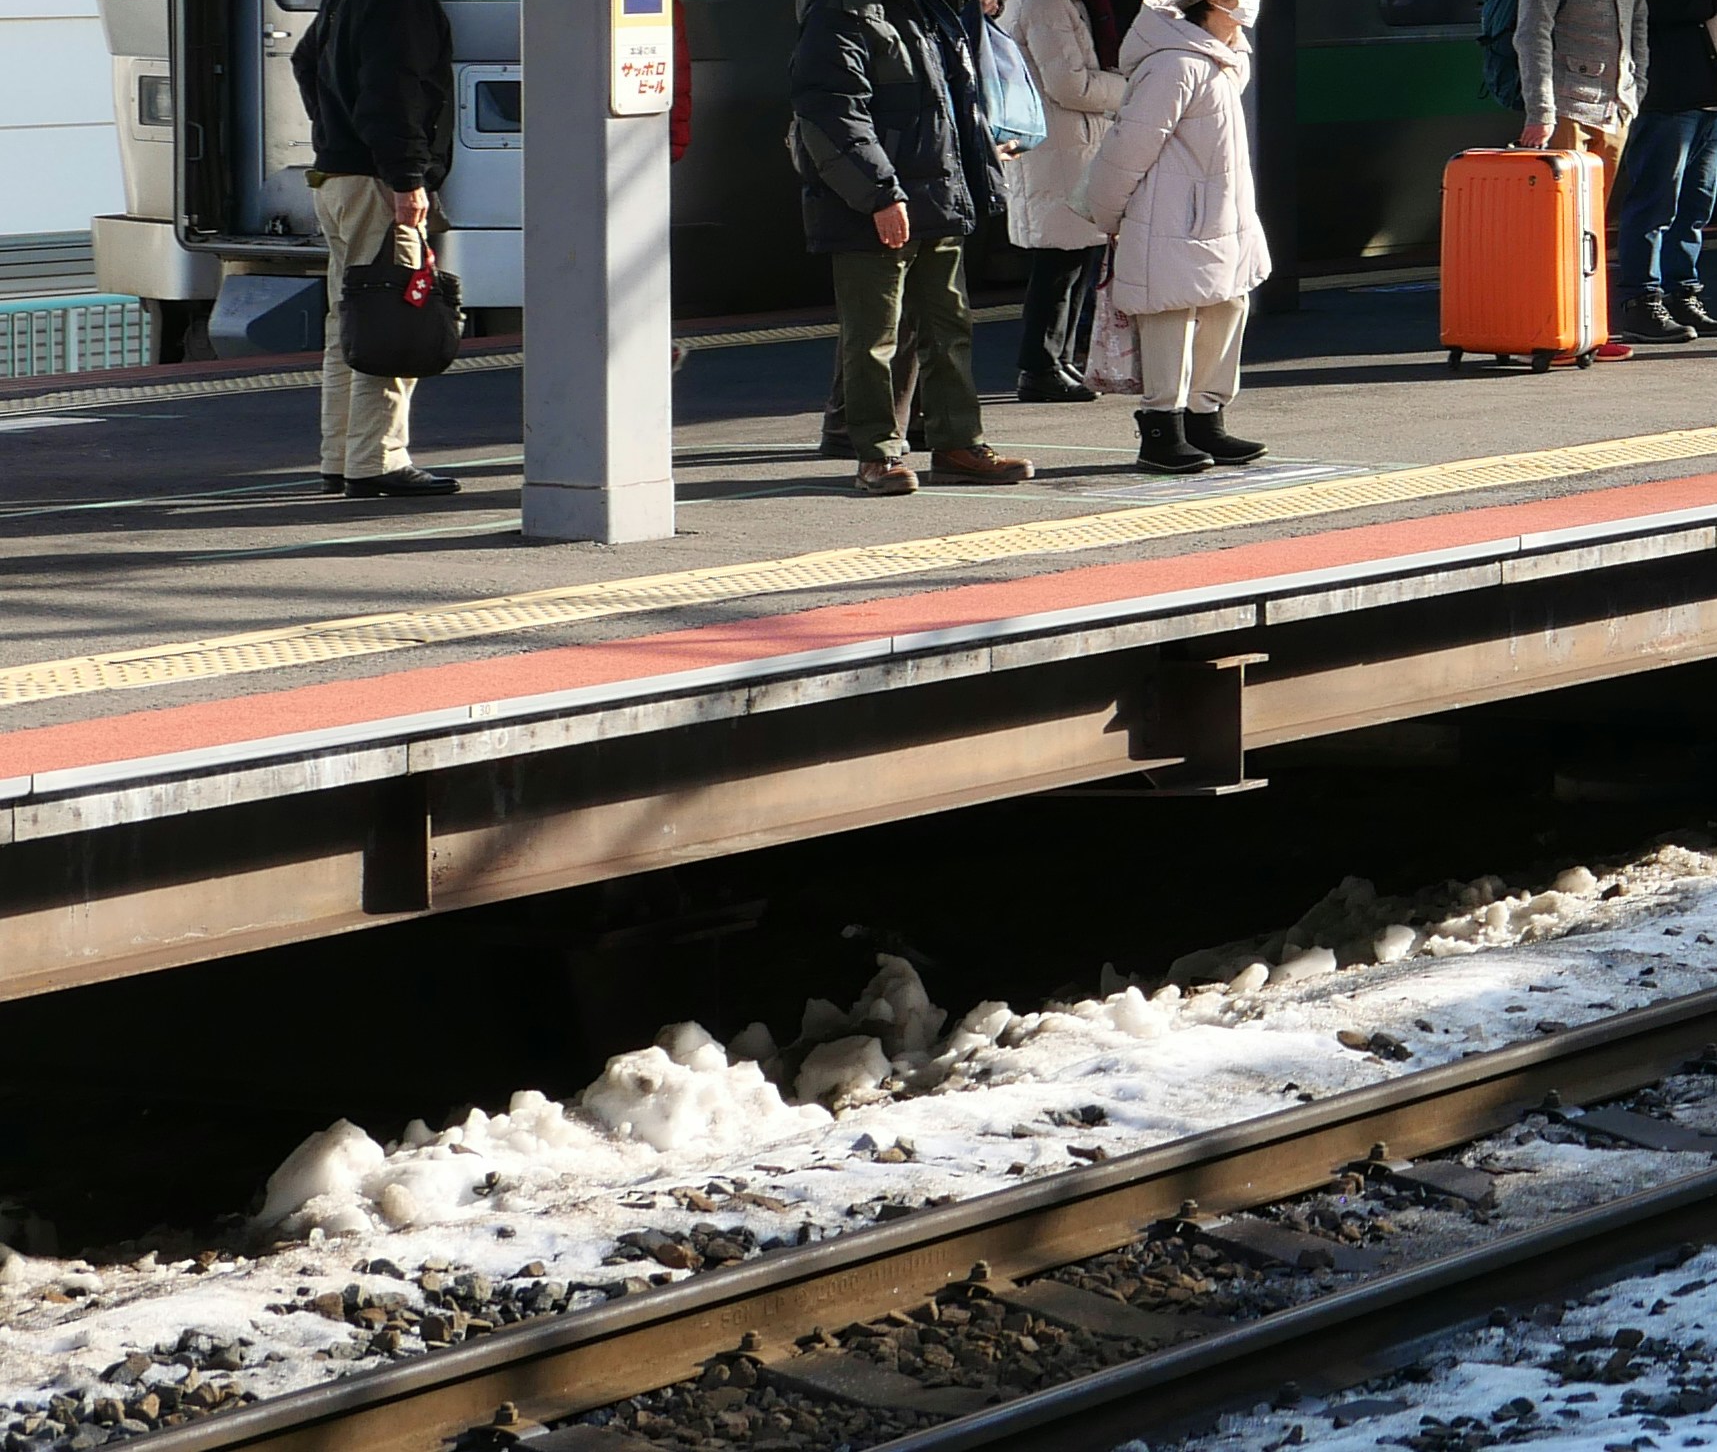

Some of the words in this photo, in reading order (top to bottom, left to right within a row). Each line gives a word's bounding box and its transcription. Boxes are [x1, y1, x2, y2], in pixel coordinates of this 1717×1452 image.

[621, 61, 666, 77] サッポロ
[638, 79, 665, 94] ビール
